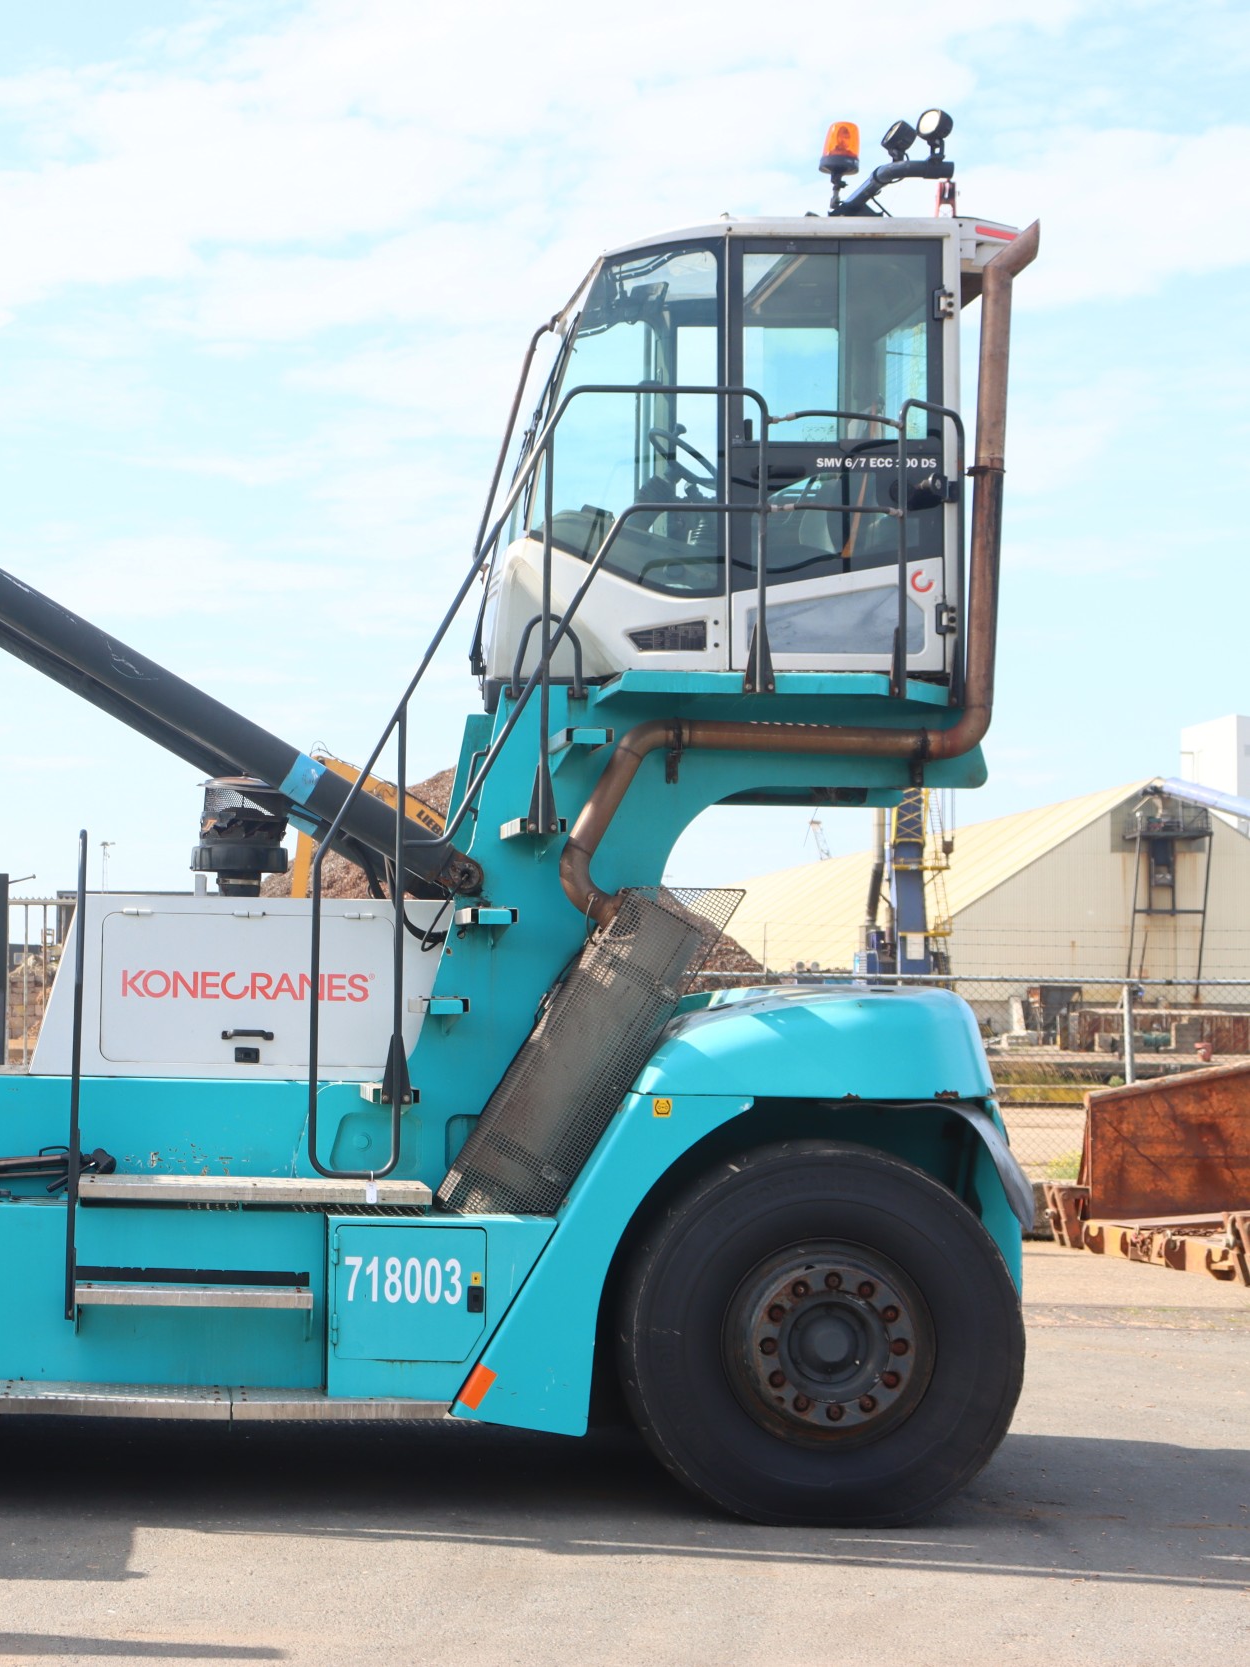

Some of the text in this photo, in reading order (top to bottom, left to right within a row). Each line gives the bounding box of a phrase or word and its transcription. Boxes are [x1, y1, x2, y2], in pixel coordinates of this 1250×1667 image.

[816, 457, 843, 468] SMV
[844, 457, 866, 470] 6/7
[869, 457, 893, 468] ECC
[921, 458, 937, 468] DS
[121, 969, 370, 1003] KONECRANES
[344, 1255, 463, 1305] 718003
